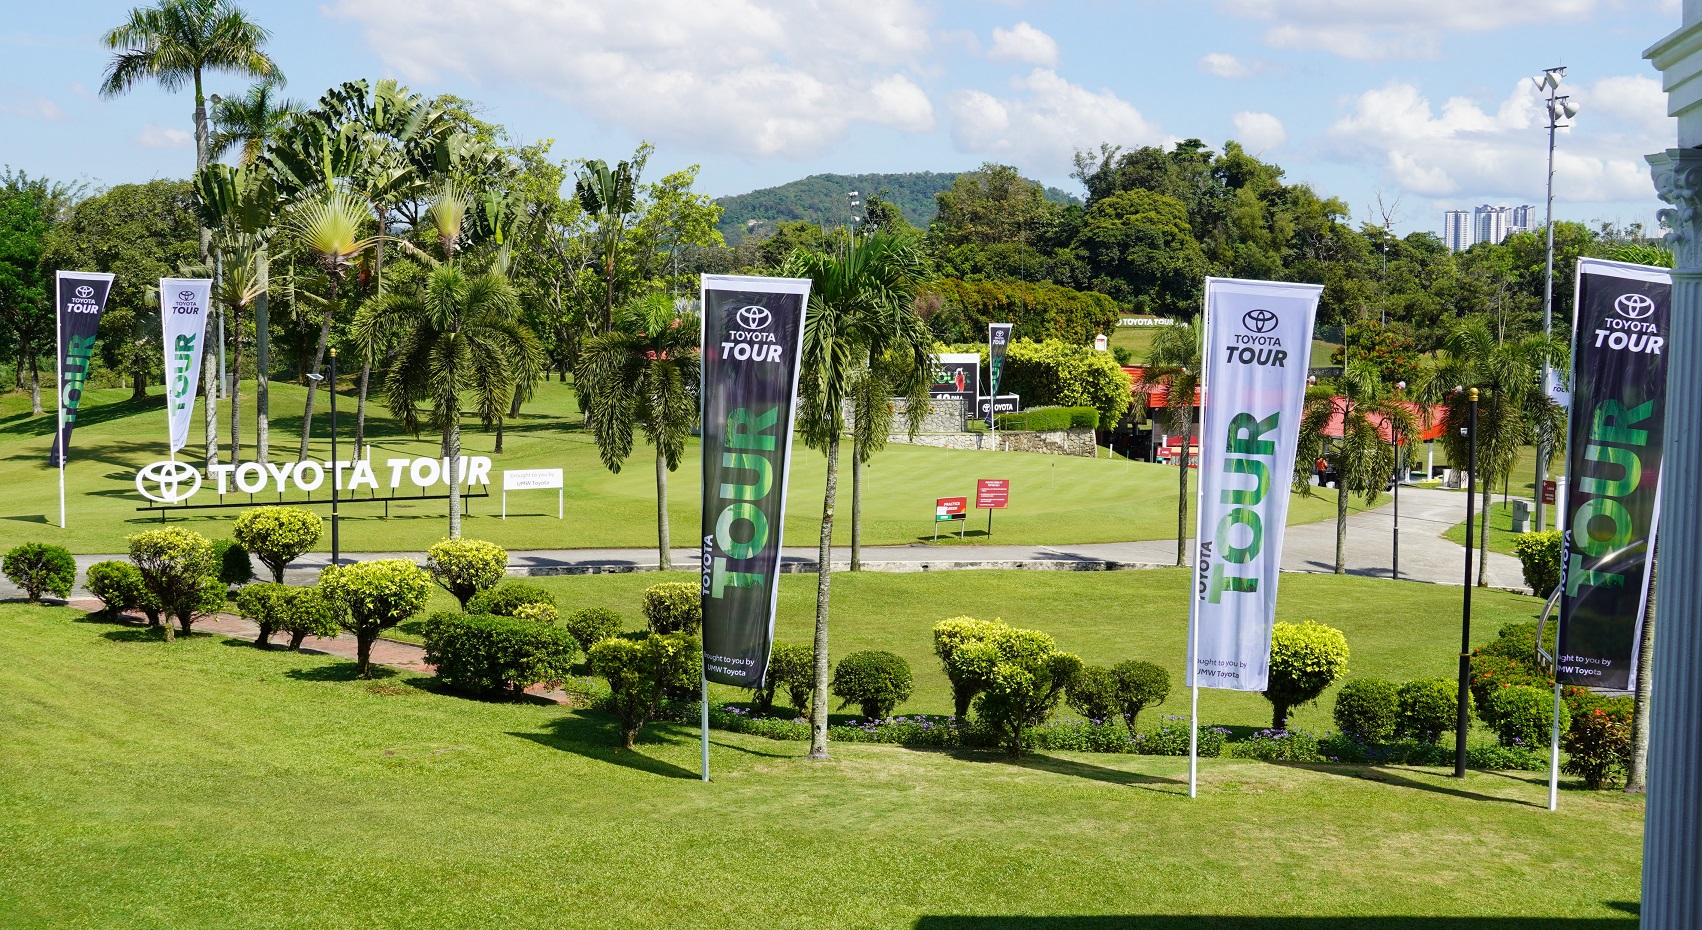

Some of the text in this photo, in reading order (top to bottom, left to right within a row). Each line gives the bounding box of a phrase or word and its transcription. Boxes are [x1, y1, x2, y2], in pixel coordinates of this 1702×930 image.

[71, 297, 96, 305] TOYOTA
[67, 303, 99, 314] TOUR
[172, 306, 200, 315] TOUR
[1122, 318, 1153, 326] TOYOTA
[1605, 317, 1658, 334] TOYOTA
[729, 330, 776, 342] TOYOTA
[1234, 334, 1282, 347] TOYOTA
[1594, 329, 1664, 355] TOUR
[721, 341, 783, 363] TOUR
[1226, 345, 1288, 368] TOUR
[171, 332, 197, 417] TOUR
[61, 334, 97, 429] TOUR
[994, 403, 1013, 411] OYOTA
[208, 455, 492, 495] TOYOTA TOUR
[711, 405, 780, 599] TOUR
[1565, 398, 1655, 598] TOUR
[1207, 410, 1281, 605] TOUR
[702, 534, 714, 596] TOYOTA
[731, 657, 745, 665] you
[745, 658, 755, 667] by
[1239, 661, 1248, 669] by
[1585, 657, 1600, 665] you
[1601, 658, 1612, 667] by
[707, 663, 746, 677] UMW Toyota
[1216, 670, 1240, 679] Toyota
[1574, 666, 1602, 676] Toyota
